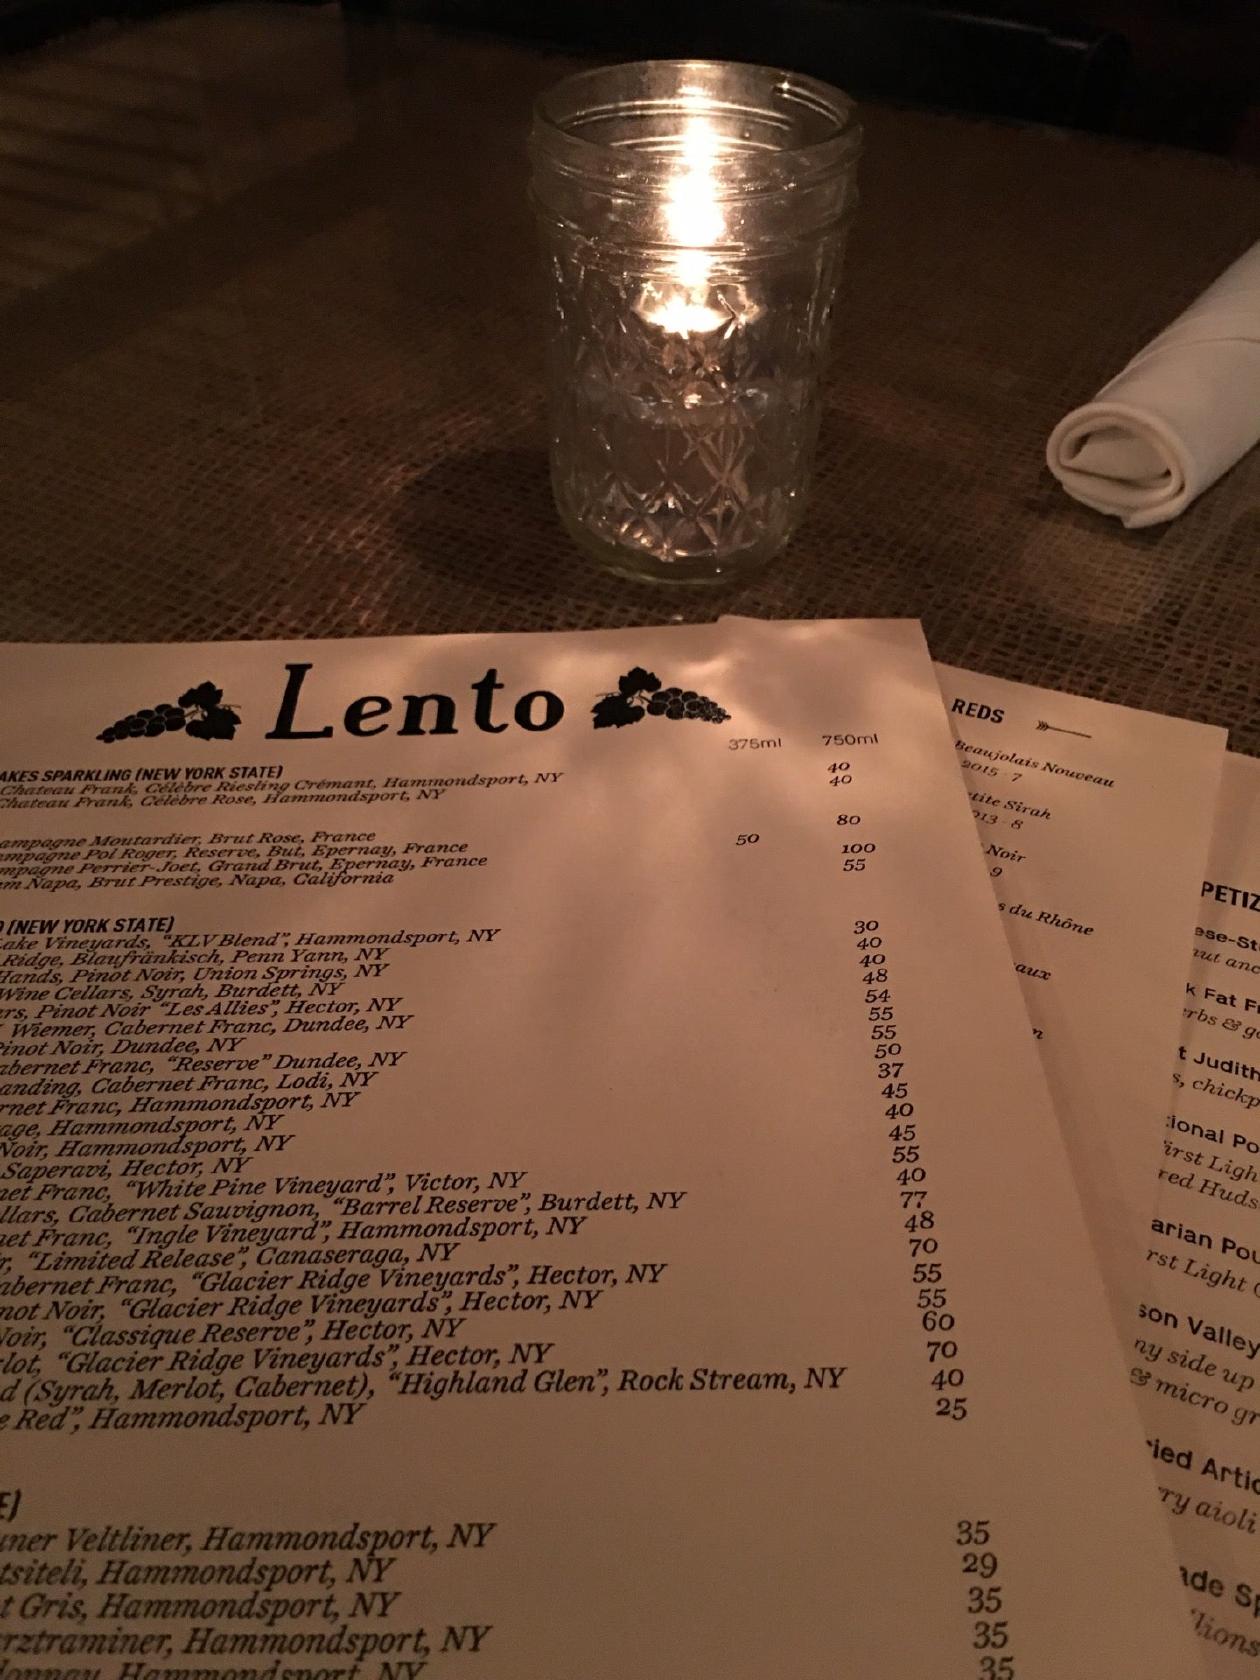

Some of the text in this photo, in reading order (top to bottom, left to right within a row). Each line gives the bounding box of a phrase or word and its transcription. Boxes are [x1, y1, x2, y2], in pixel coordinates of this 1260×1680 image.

[265, 661, 565, 741] Lento
[951, 698, 1004, 724] REDS
[728, 732, 879, 750] 375ml 750ml
[42, 765, 283, 784] SPARKLING (NEW YORK STATE)
[827, 761, 851, 773] 40
[1040, 761, 1115, 788] Nouveau
[215, 781, 287, 794] Riesling
[534, 773, 565, 784] NY
[829, 775, 853, 787] 40
[836, 814, 861, 826] 80
[1002, 800, 1052, 820] Sirah
[208, 832, 252, 844] Brut
[310, 831, 376, 843] France
[735, 833, 760, 846] 50
[402, 842, 468, 854] France
[841, 843, 876, 855] 100
[986, 844, 1027, 863] Noir
[208, 858, 271, 871] Grand
[421, 855, 488, 867] France
[842, 859, 866, 872] 55
[989, 865, 1003, 878] 9
[87, 875, 136, 888] Brut
[293, 871, 394, 887] California
[6, 917, 175, 939] (NEW YORK STATE)
[853, 920, 879, 934] 30
[1008, 903, 1094, 936] du Rhône
[45, 929, 502, 952] Vineyards, Hammondsport, NY
[856, 937, 882, 950] 40
[2, 952, 63, 969] Ridge,
[231, 949, 284, 963] Penn
[291, 949, 348, 964] Yann,
[354, 947, 392, 961] NY
[859, 954, 886, 967] 40
[71, 964, 390, 984] Pinot Noir, Union Springs, NY
[862, 969, 888, 984] 48
[55, 986, 133, 1001] Cellars,
[141, 985, 207, 1002] Syrah,
[216, 983, 301, 999] Burdett,
[308, 982, 345, 996] NY
[865, 989, 891, 1003] 54
[1204, 987, 1237, 1008] Fat
[34, 997, 404, 1019] Pinot Noir Hector, NY
[868, 1006, 894, 1021] 55
[11, 1015, 414, 1039] Wiemer, Cabernet Franc, Dundee, NY
[871, 1025, 897, 1040] 55
[874, 1043, 901, 1059] 50
[877, 1063, 904, 1078] 37
[91, 1075, 195, 1093] Cabernet
[199, 1075, 268, 1093] Franc,
[275, 1073, 334, 1091] Lodi,
[340, 1071, 380, 1087] NY
[881, 1082, 908, 1099] 45
[884, 1102, 914, 1119] 40
[888, 1125, 916, 1141] 45
[892, 1145, 920, 1163] 55
[1, 1156, 254, 1183] Saperavi, Hector, NY
[896, 1167, 926, 1186] 40
[68, 1190, 687, 1223] Cabernet Sauvignon, Burdett, NY
[900, 1191, 928, 1208] 77
[904, 1210, 935, 1232] 48
[1151, 1217, 1213, 1249] arian
[256, 1242, 461, 1267] Canaseraga, NY
[908, 1237, 938, 1257] 70
[96, 1263, 668, 1297] Franc, Ridge Hector, NY
[912, 1263, 942, 1283] 55
[1183, 1258, 1248, 1293] Light
[916, 1289, 947, 1308] 55
[921, 1310, 955, 1331] 60
[926, 1339, 958, 1362] 70
[931, 1368, 964, 1390] 40
[1167, 1349, 1217, 1378] side
[1222, 1368, 1256, 1393] up
[24, 1367, 848, 1405] (Syrah, Merlot, Cabernet), Rock Stream, NY
[1156, 1377, 1229, 1415] micro
[935, 1397, 968, 1421] 25
[1196, 1500, 1258, 1535] aioli
[67, 1524, 497, 1556] Veltliner, Hammondsport, NY
[956, 1520, 991, 1546] 35
[97, 1558, 337, 1591] Hammondsport,
[345, 1558, 397, 1583] NY
[962, 1552, 998, 1579] 29
[967, 1586, 1003, 1614] 35
[972, 1620, 1009, 1650] 35
